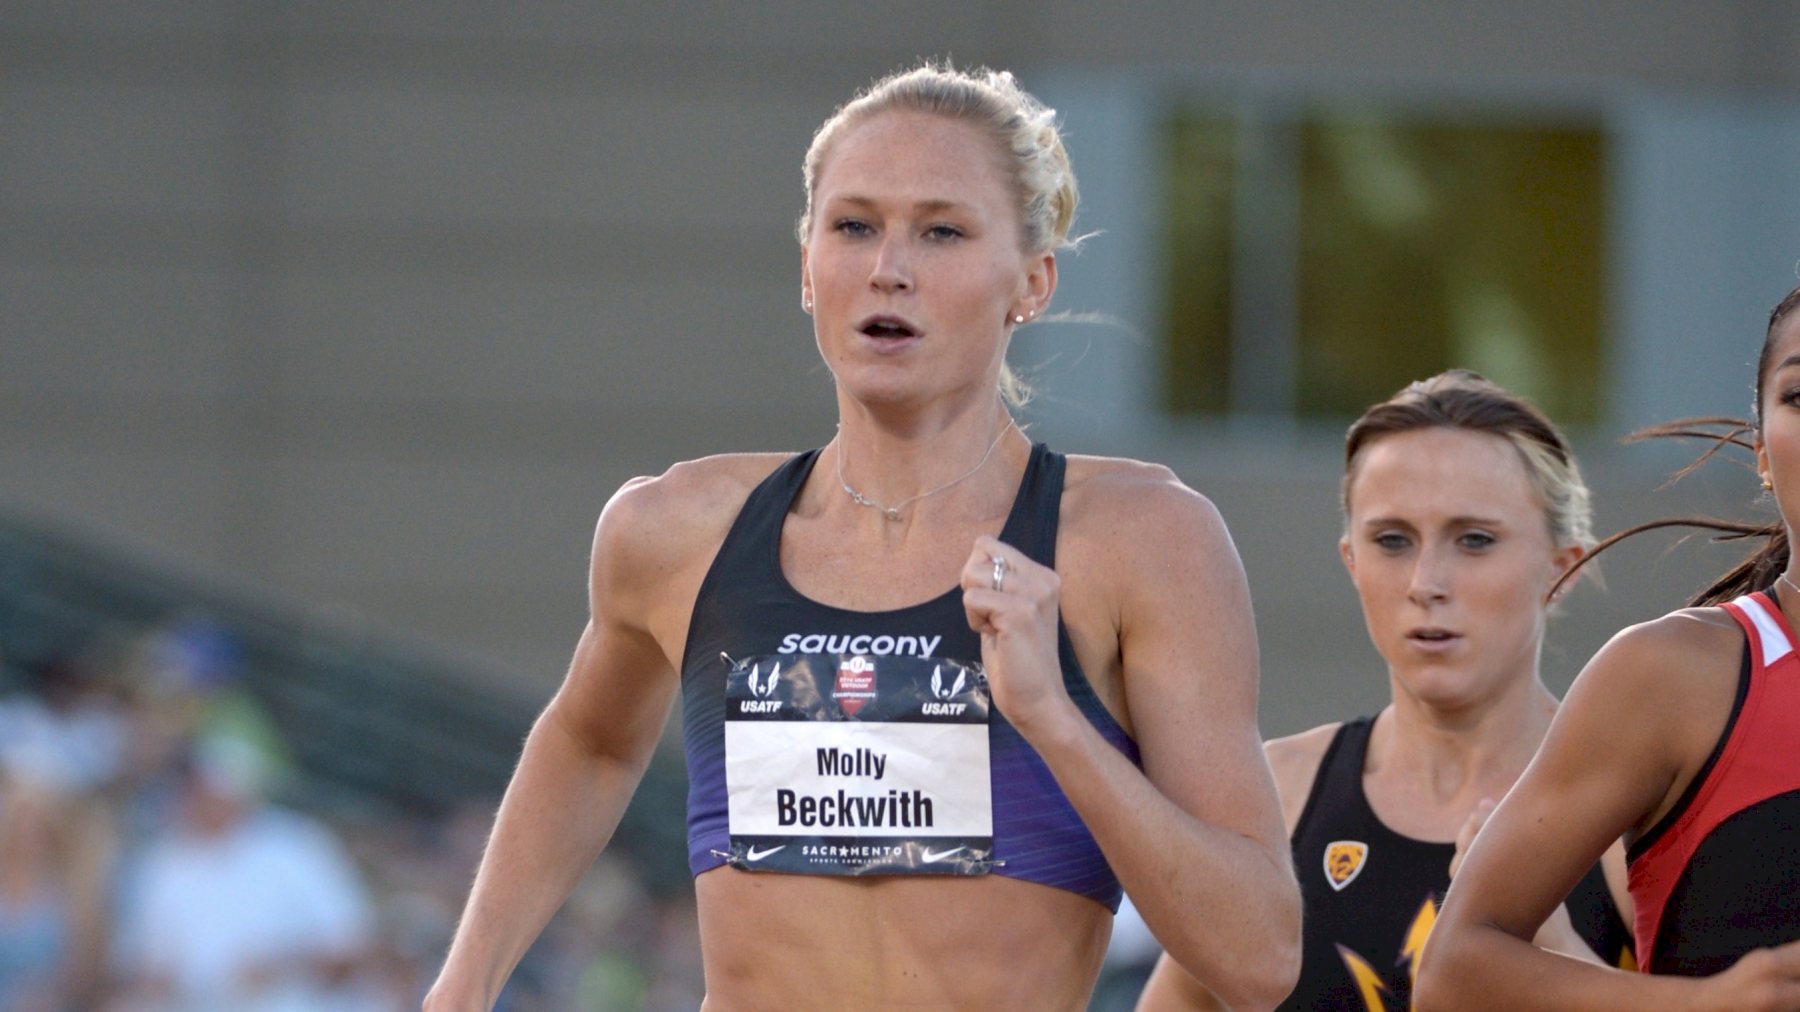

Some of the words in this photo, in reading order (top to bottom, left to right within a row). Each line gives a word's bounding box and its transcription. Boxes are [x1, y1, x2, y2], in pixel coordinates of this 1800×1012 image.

[777, 633, 942, 660] saucony
[740, 700, 782, 713] USATF
[921, 702, 967, 716] USATF
[816, 747, 887, 780] Molly
[777, 788, 933, 828] Beckwith
